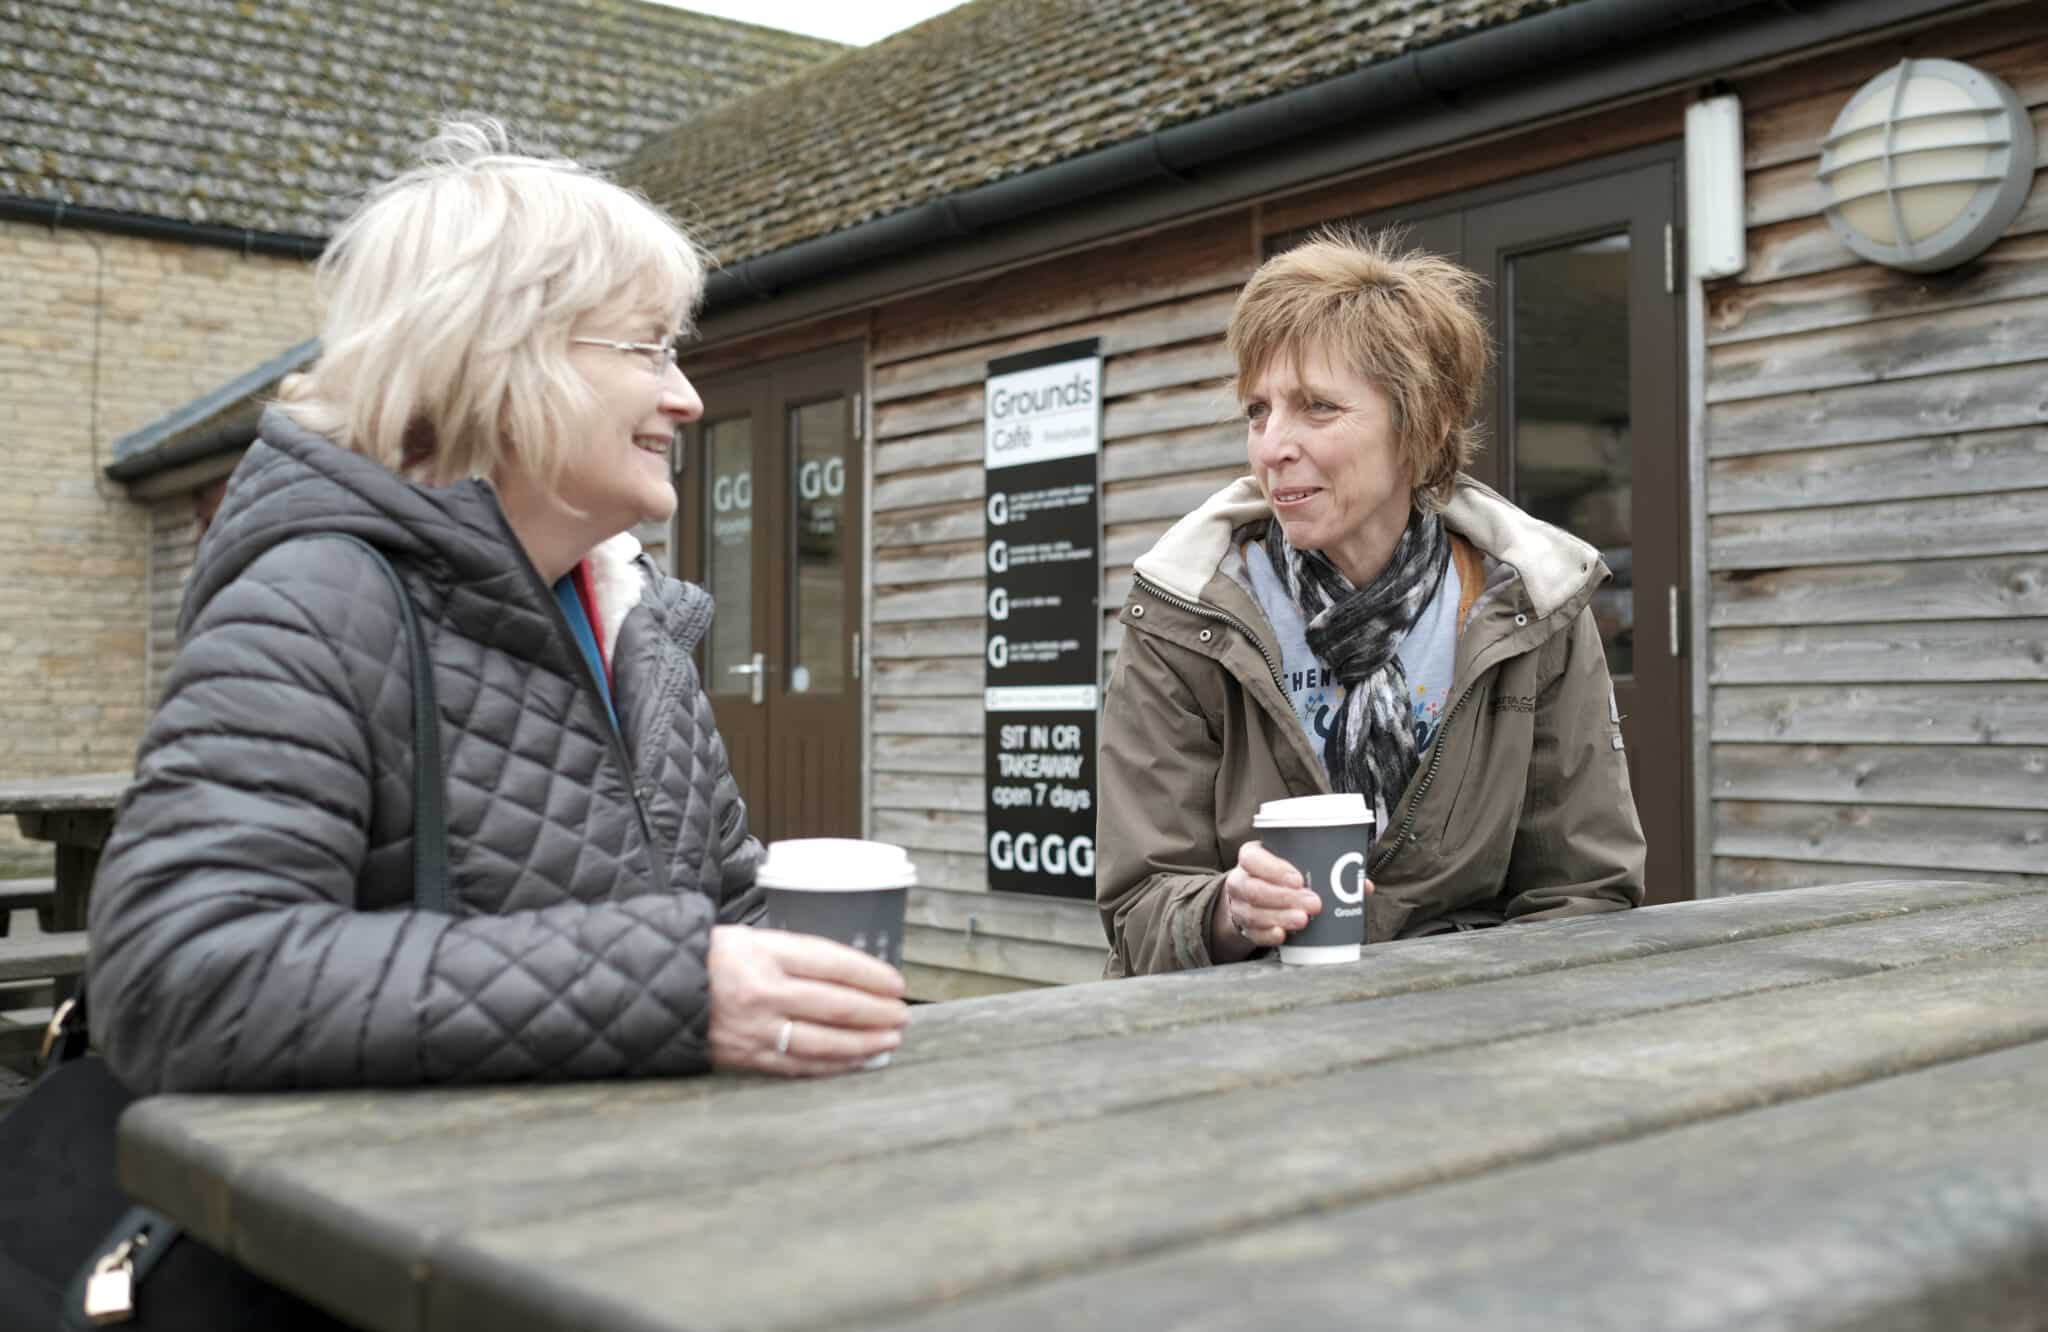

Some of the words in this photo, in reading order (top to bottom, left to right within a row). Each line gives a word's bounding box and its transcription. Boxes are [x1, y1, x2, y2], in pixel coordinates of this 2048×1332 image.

[992, 373, 1092, 418] Grounds
[988, 492, 1008, 525] G
[988, 540, 1008, 573] G
[988, 588, 1008, 620] G
[988, 636, 1008, 668] G
[1284, 669, 1342, 691] HEN
[1000, 724, 1027, 750] SIT
[1030, 724, 1049, 750] IN
[1052, 724, 1081, 751] OR
[997, 753, 1084, 779] TAKEAWAY
[992, 786, 1032, 809] open
[1034, 782, 1048, 807] 7
[1050, 783, 1091, 813] days
[1330, 851, 1365, 904] G
